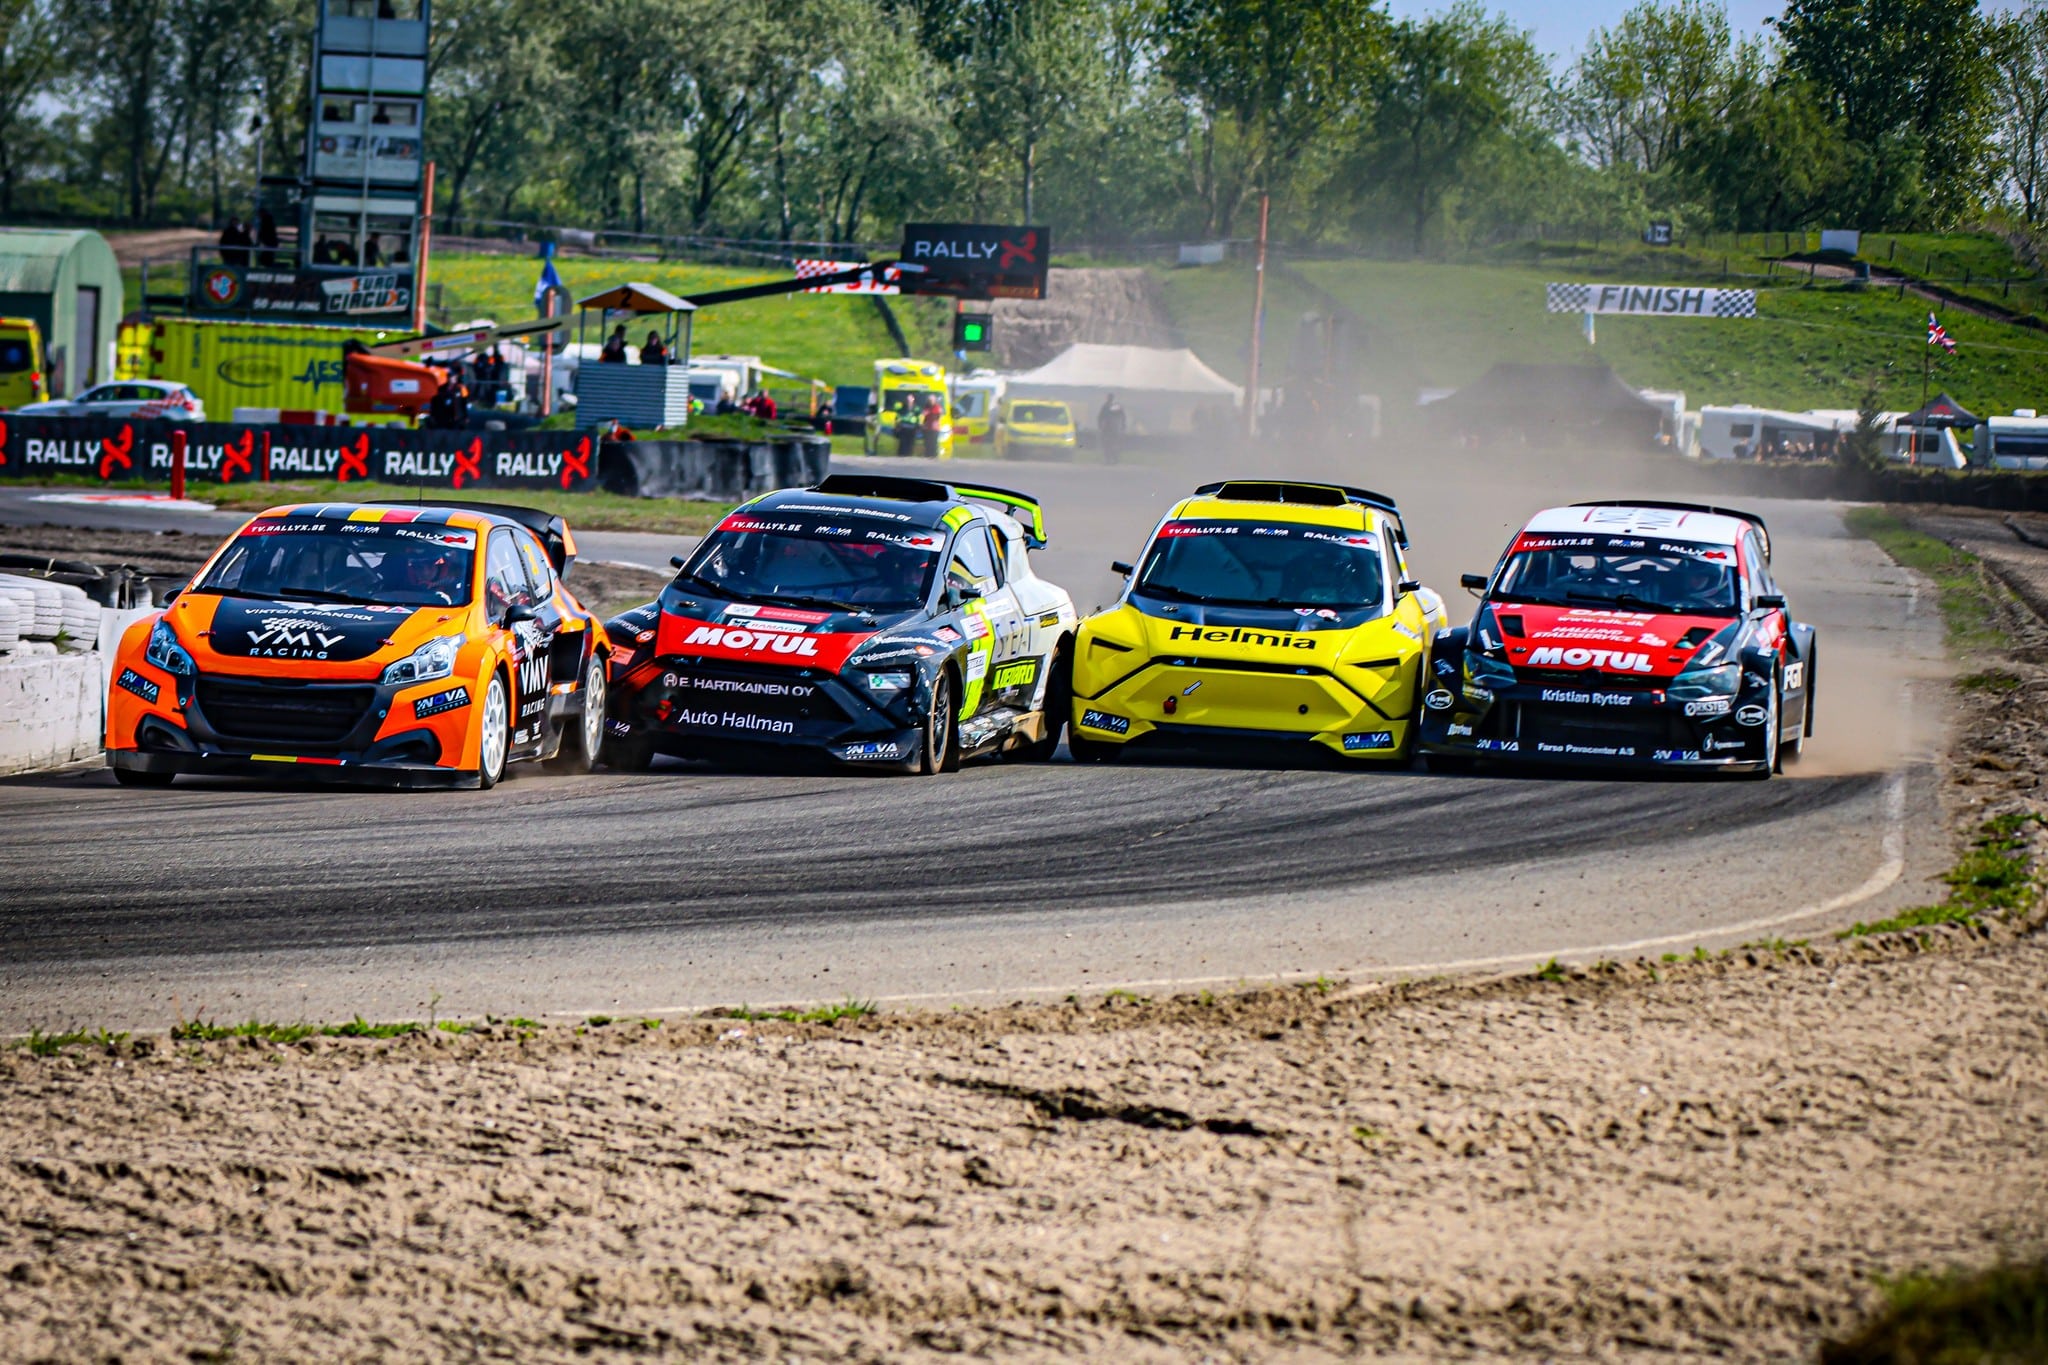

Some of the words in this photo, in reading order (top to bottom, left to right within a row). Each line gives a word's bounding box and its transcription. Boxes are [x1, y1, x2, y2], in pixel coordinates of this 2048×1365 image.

[620, 287, 634, 307] 2
[1597, 286, 1705, 313] FINISH
[151, 429, 254, 483] RLLYX
[302, 610, 374, 621] VRANCKX
[246, 631, 346, 648] VMV
[683, 626, 819, 656] MOTUL
[1169, 627, 1317, 650] Helmia
[249, 648, 329, 660] RACING
[1527, 647, 1654, 672] MOTUL
[520, 655, 549, 696] VMV
[694, 678, 789, 696] HARTIKAINEN
[792, 686, 815, 697] OY
[1542, 689, 1590, 704] Kristian
[1592, 692, 1633, 706] Rytter
[521, 698, 546, 717] RACING
[678, 709, 718, 725] Auto
[721, 711, 794, 734] Hallman
